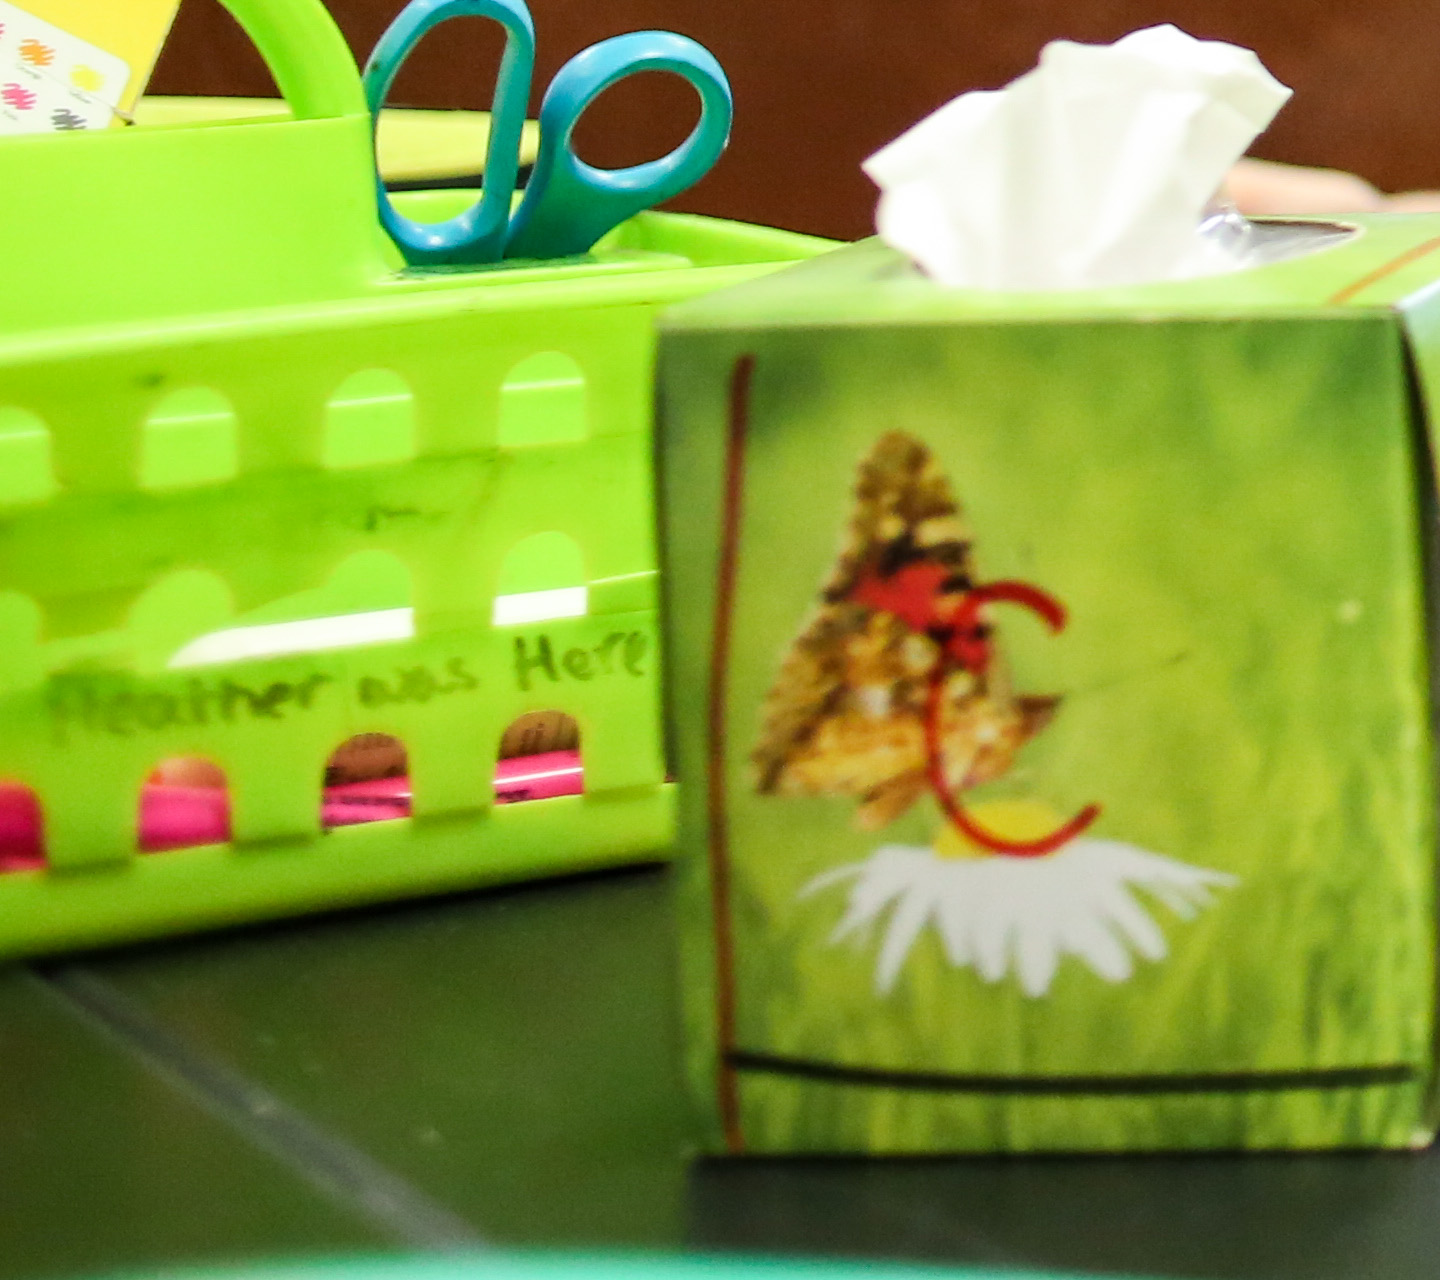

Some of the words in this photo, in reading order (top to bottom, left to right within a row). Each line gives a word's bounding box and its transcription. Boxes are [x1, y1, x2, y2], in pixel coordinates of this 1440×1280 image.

[46, 670, 332, 734] Heather
[358, 658, 480, 706] was
[512, 634, 650, 692] Here
